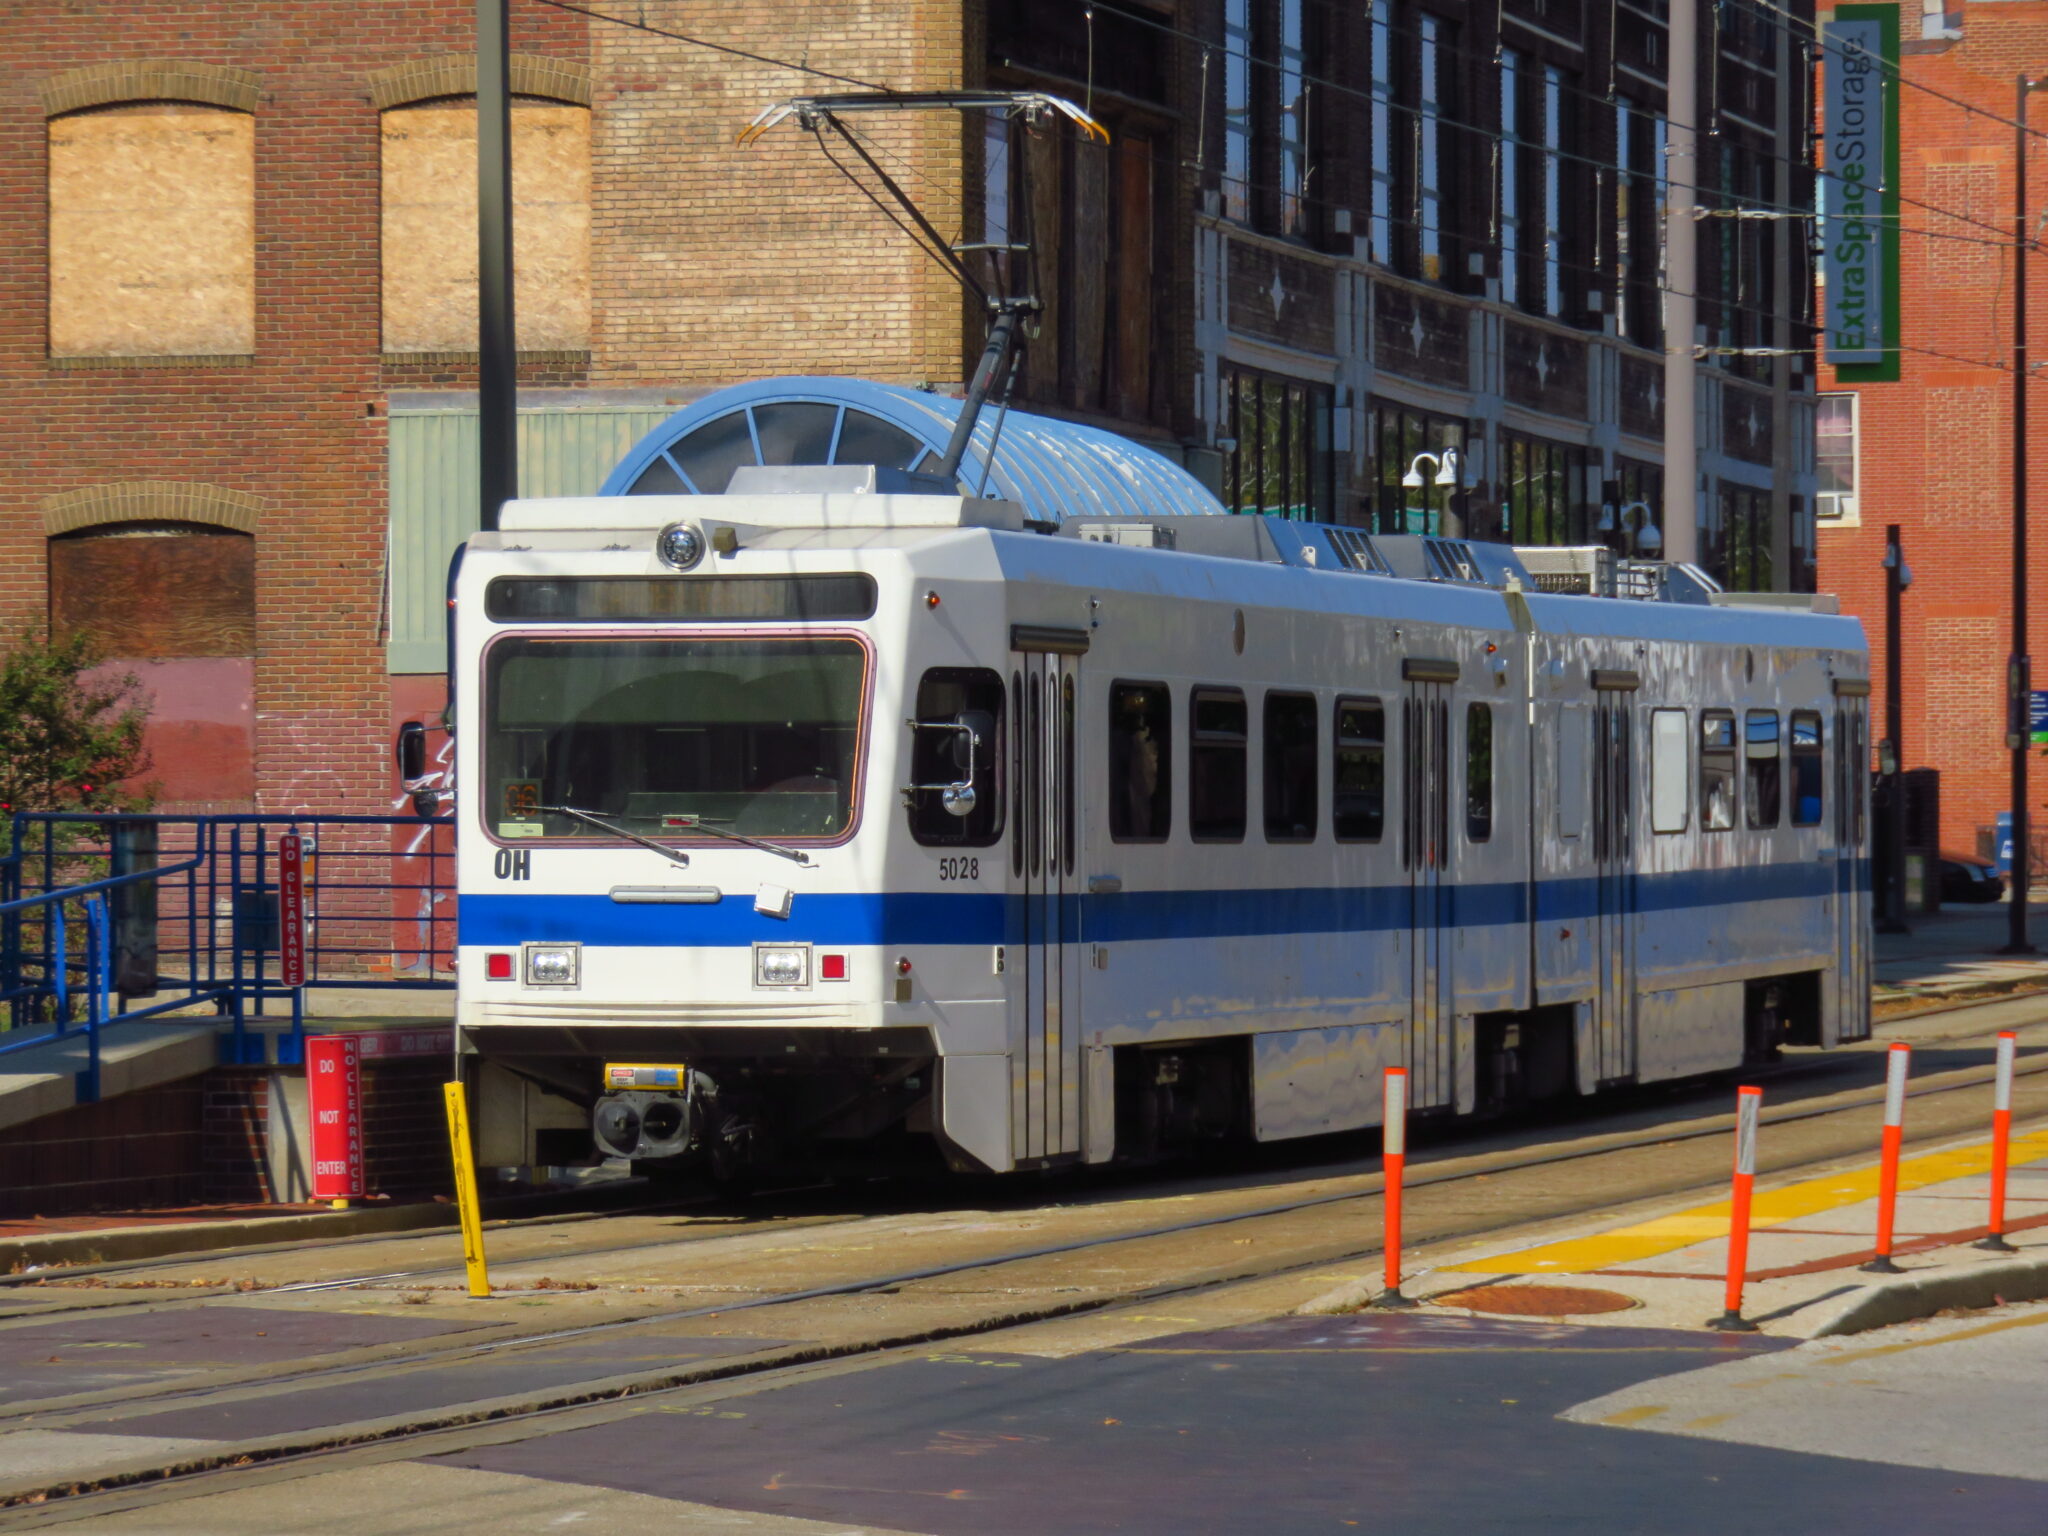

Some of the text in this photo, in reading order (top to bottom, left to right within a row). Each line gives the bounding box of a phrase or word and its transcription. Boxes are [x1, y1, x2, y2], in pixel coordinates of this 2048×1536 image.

[494, 848, 530, 880] OH
[939, 856, 979, 881] 5028
[285, 837, 298, 984] NO CLEARANCE
[320, 1059, 335, 1074] DO
[319, 1110, 340, 1124] NOT
[344, 1041, 360, 1193] NO CLEARANCE
[316, 1161, 346, 1175] ENTER
